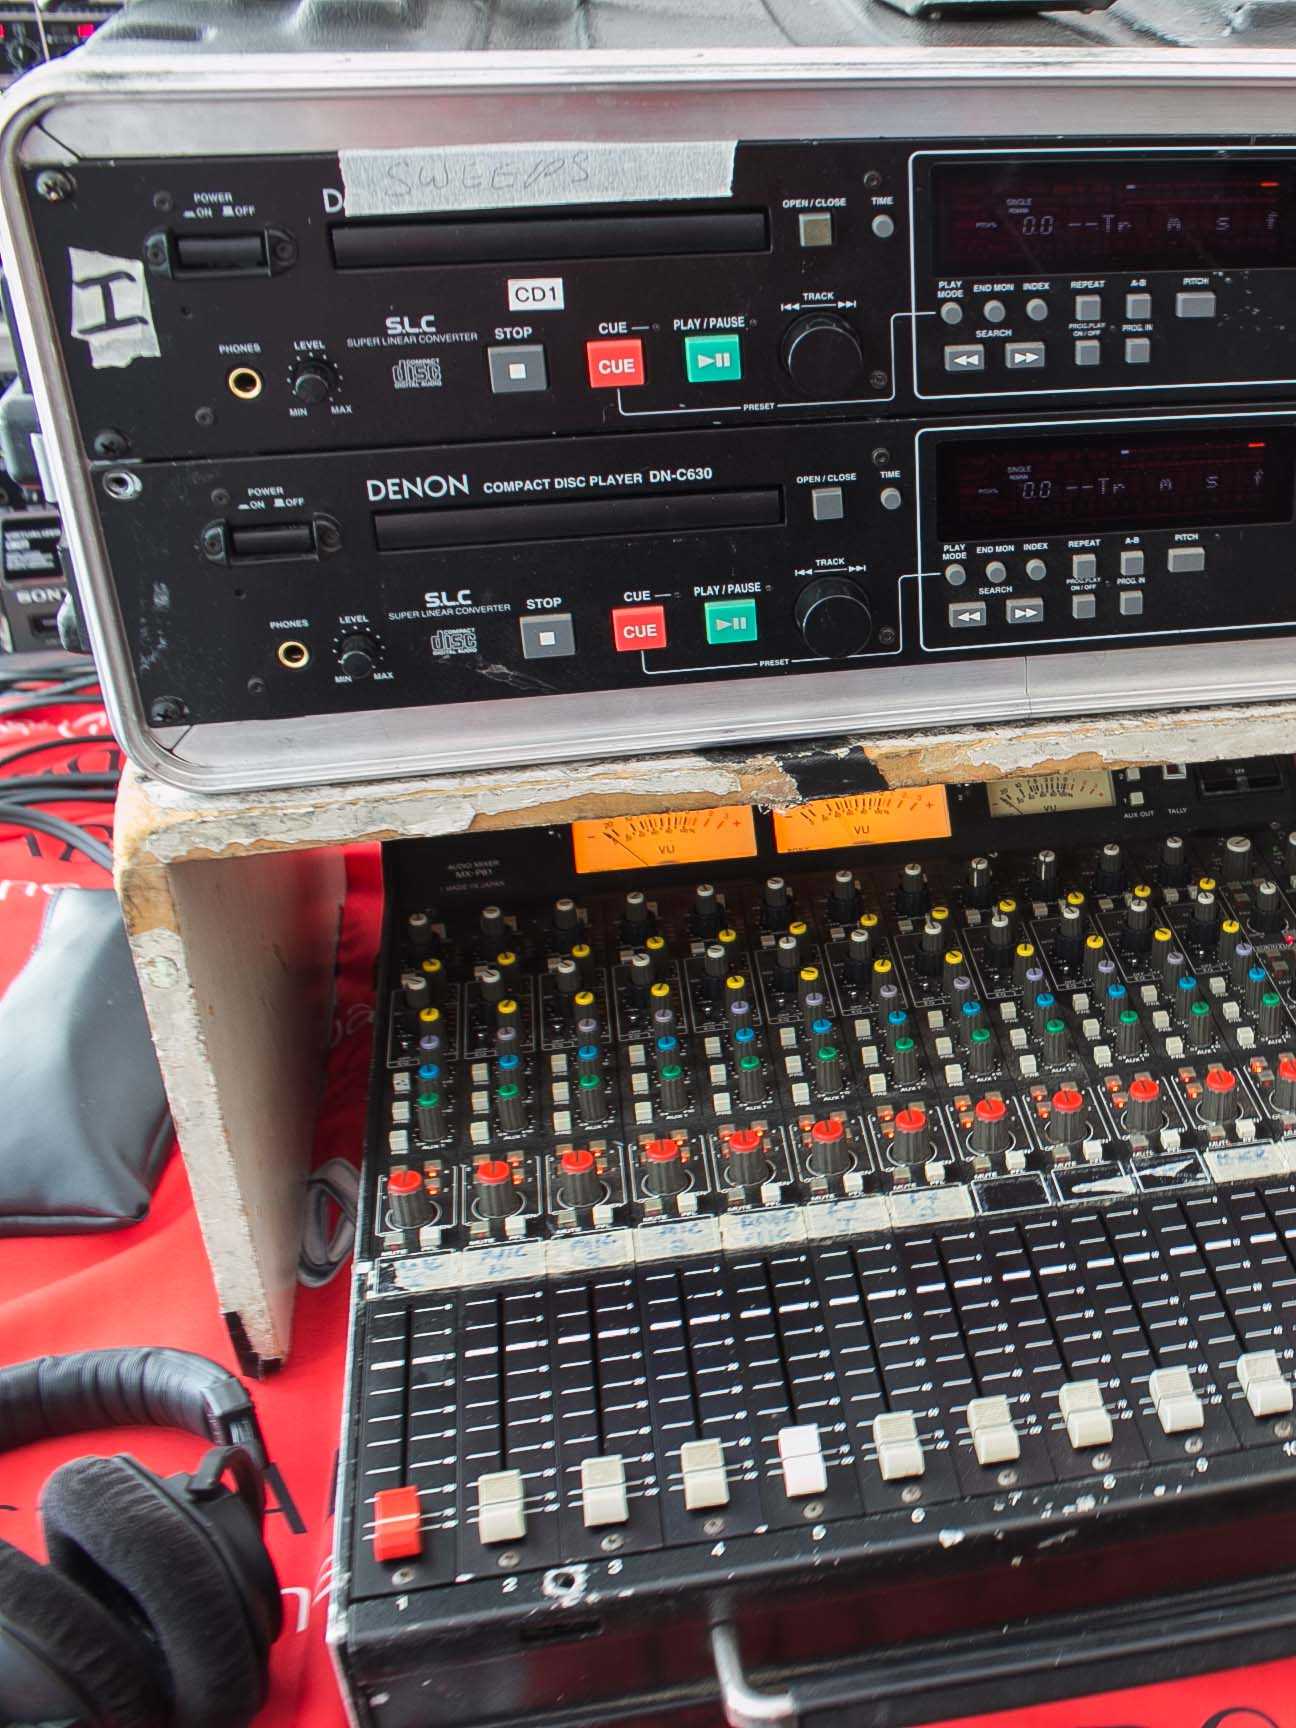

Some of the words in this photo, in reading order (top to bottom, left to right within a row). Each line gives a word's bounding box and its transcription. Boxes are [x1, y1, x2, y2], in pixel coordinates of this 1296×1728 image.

[194, 192, 232, 203] POWER
[872, 196, 894, 205] TIME
[196, 207, 213, 217] ON
[234, 205, 255, 216] OFF
[938, 280, 962, 290] PLAY
[1022, 281, 1050, 291] INDEX
[1070, 279, 1105, 289] REPEAT
[514, 286, 557, 304] CD1
[803, 291, 834, 301] TRACK
[937, 289, 964, 298] MODE
[598, 321, 628, 335] CUE
[494, 326, 533, 341] STOP
[975, 329, 1013, 338] SEARCH
[346, 336, 380, 348] SUPER
[381, 334, 418, 346] LINEAR
[418, 331, 478, 344] CONVERTER
[219, 343, 261, 354] PHONES
[294, 340, 326, 350] LEVEL
[598, 358, 636, 375] CUE
[330, 405, 353, 415] MAX
[743, 402, 775, 411] PRESET
[289, 408, 308, 417] MIN
[880, 470, 901, 479] TIME
[366, 474, 470, 501] DENON
[483, 478, 551, 494] COMPACT
[554, 476, 587, 489] DISC
[590, 473, 643, 487] PLAYER
[650, 467, 713, 483] DN-C630
[247, 487, 284, 497] POWER
[250, 500, 266, 510] ON
[286, 498, 304, 507] OFF
[1174, 533, 1199, 542] PITCH
[943, 543, 966, 552] PLAY
[1022, 542, 1048, 551] INDEX
[1067, 539, 1101, 548] REPEAT
[976, 545, 993, 554] END
[994, 544, 1015, 553] MON
[942, 552, 967, 560] MODE
[815, 557, 845, 567] TRACK
[978, 586, 1013, 595] SEARCH
[623, 590, 651, 602] CUE
[526, 597, 563, 610] STOP
[388, 610, 419, 621] SUPER
[420, 607, 455, 619] LINEAR
[455, 603, 511, 616] CONVERTER
[269, 619, 309, 629] PHONES
[339, 614, 369, 624] LEVEL
[623, 624, 657, 639] CUE
[759, 658, 790, 667] PRESET
[334, 675, 353, 683] MIN
[373, 672, 394, 681] MAX
[853, 825, 870, 834] VU
[658, 844, 675, 855] VU
[711, 1542, 726, 1556] 4
[607, 1559, 623, 1575] 3
[502, 1577, 519, 1594] 2
[395, 1595, 409, 1611] 1
